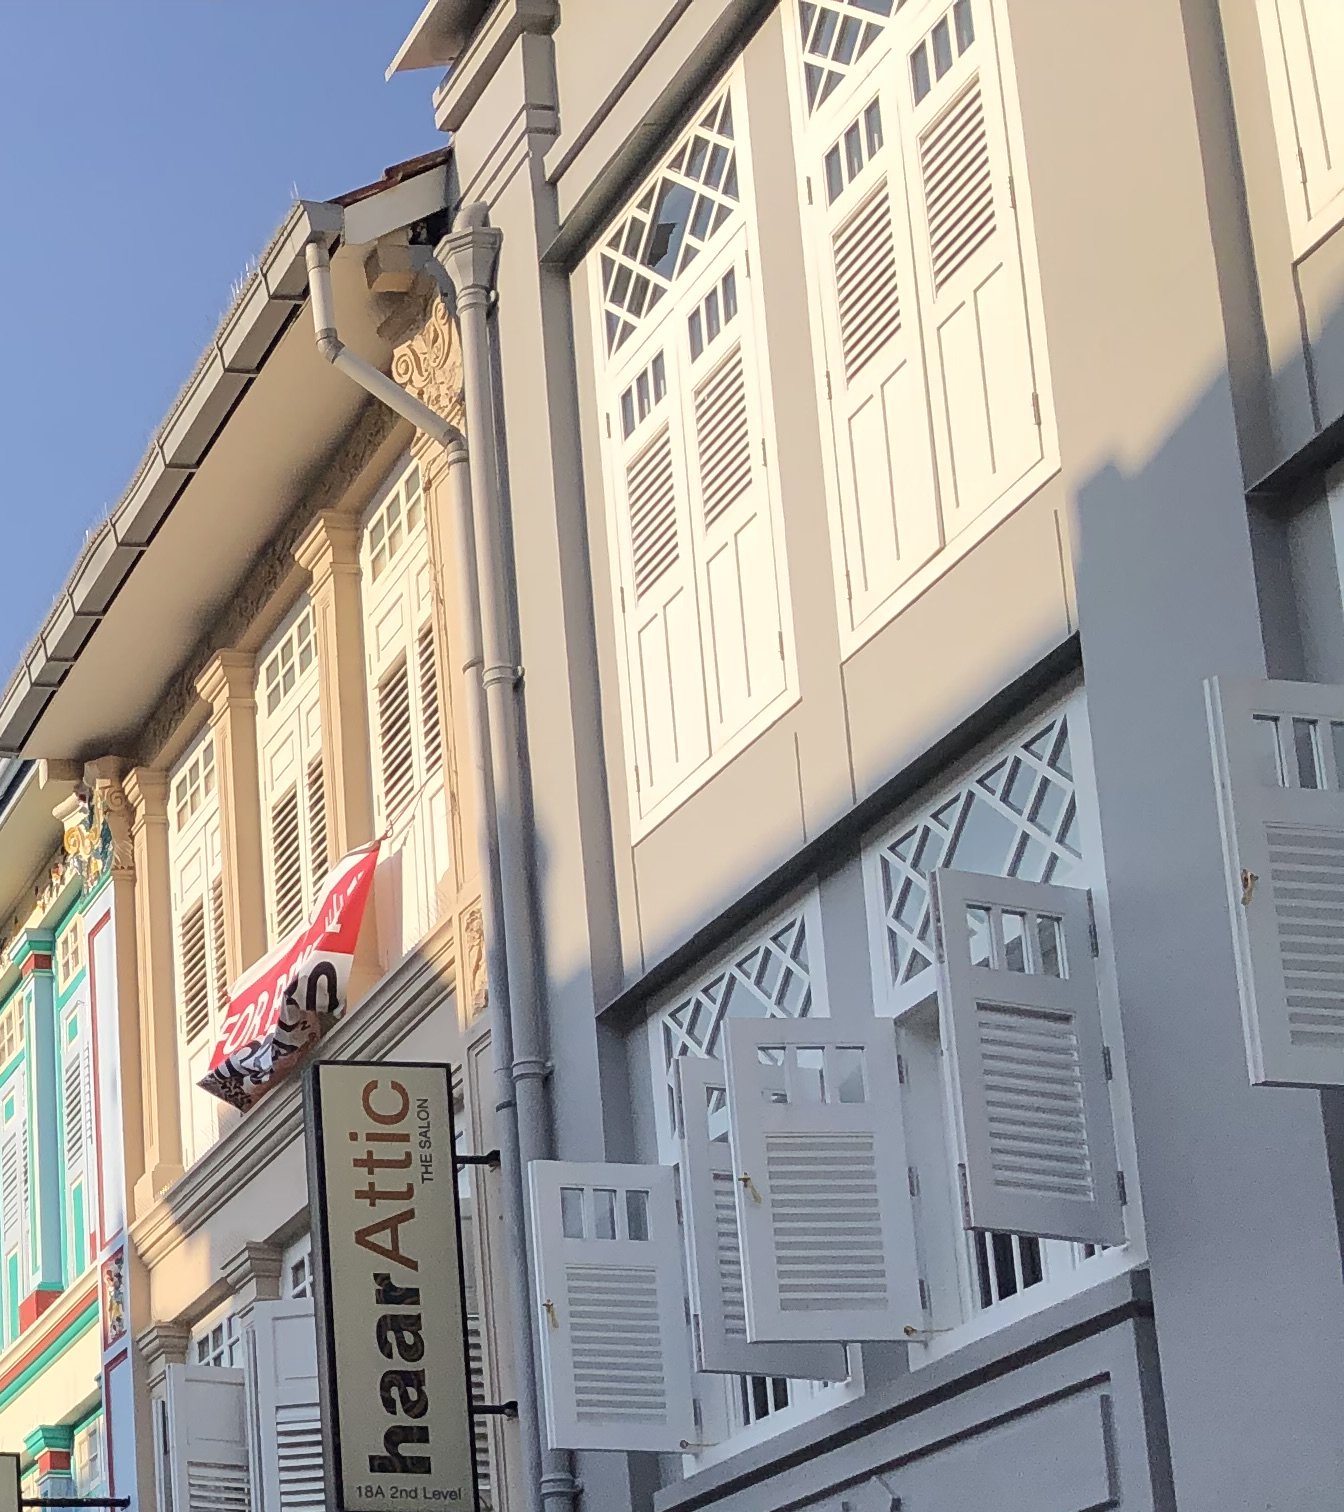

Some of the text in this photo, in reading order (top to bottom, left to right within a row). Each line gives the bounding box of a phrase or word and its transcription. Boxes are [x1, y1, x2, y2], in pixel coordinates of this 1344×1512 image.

[416, 1098, 435, 1185] THE SALON
[355, 1486, 462, 1500] 18A 2nd Level
